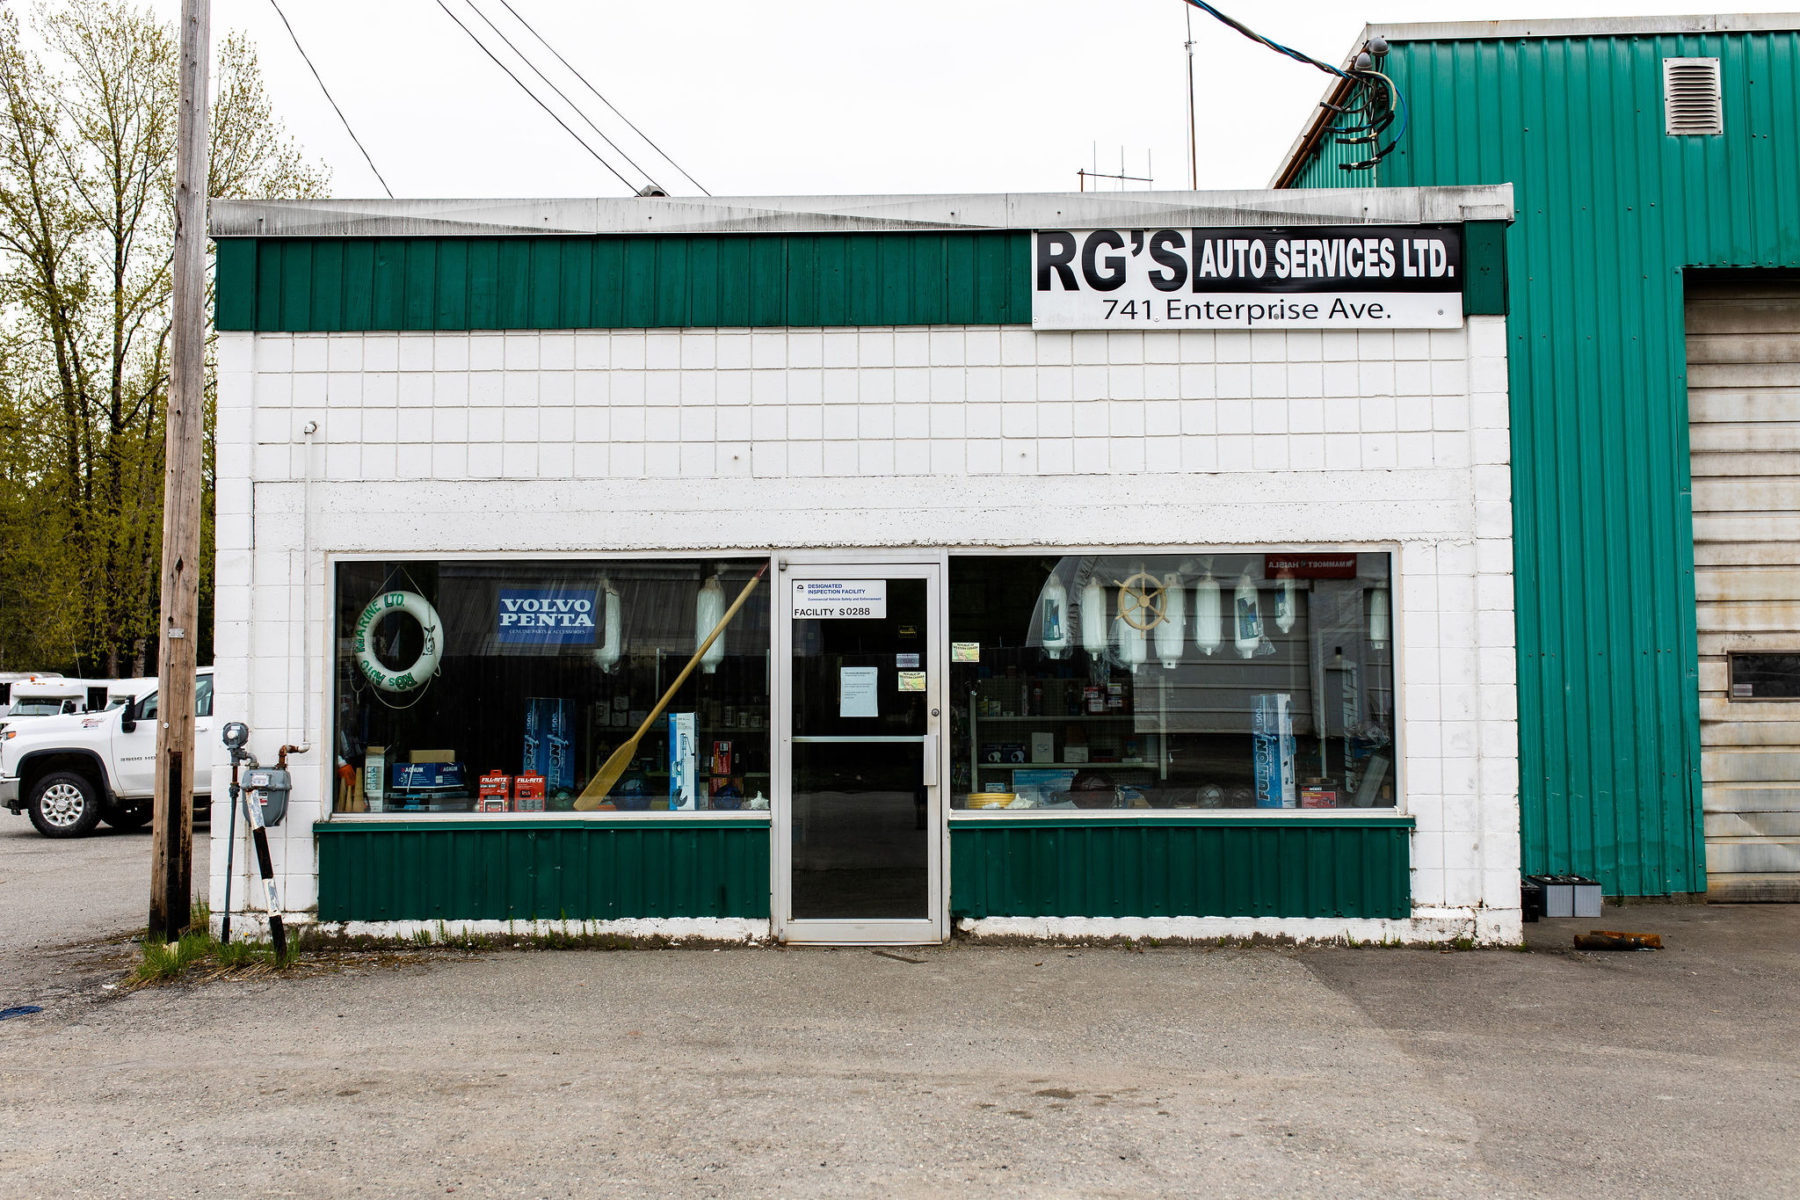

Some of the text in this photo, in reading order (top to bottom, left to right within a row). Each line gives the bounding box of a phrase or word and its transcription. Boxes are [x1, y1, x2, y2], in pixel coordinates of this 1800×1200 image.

[1036, 229, 1455, 292] RG'S AUTO SERVICES LTD.
[1103, 297, 1391, 325] 741 Enterprise Ave.
[501, 598, 591, 612] VOLVO
[794, 608, 835, 616] FACILITY
[355, 600, 382, 653] MARINE
[500, 613, 595, 627] PENTA
[360, 660, 387, 686] AUTO
[1255, 738, 1270, 801] FULTON
